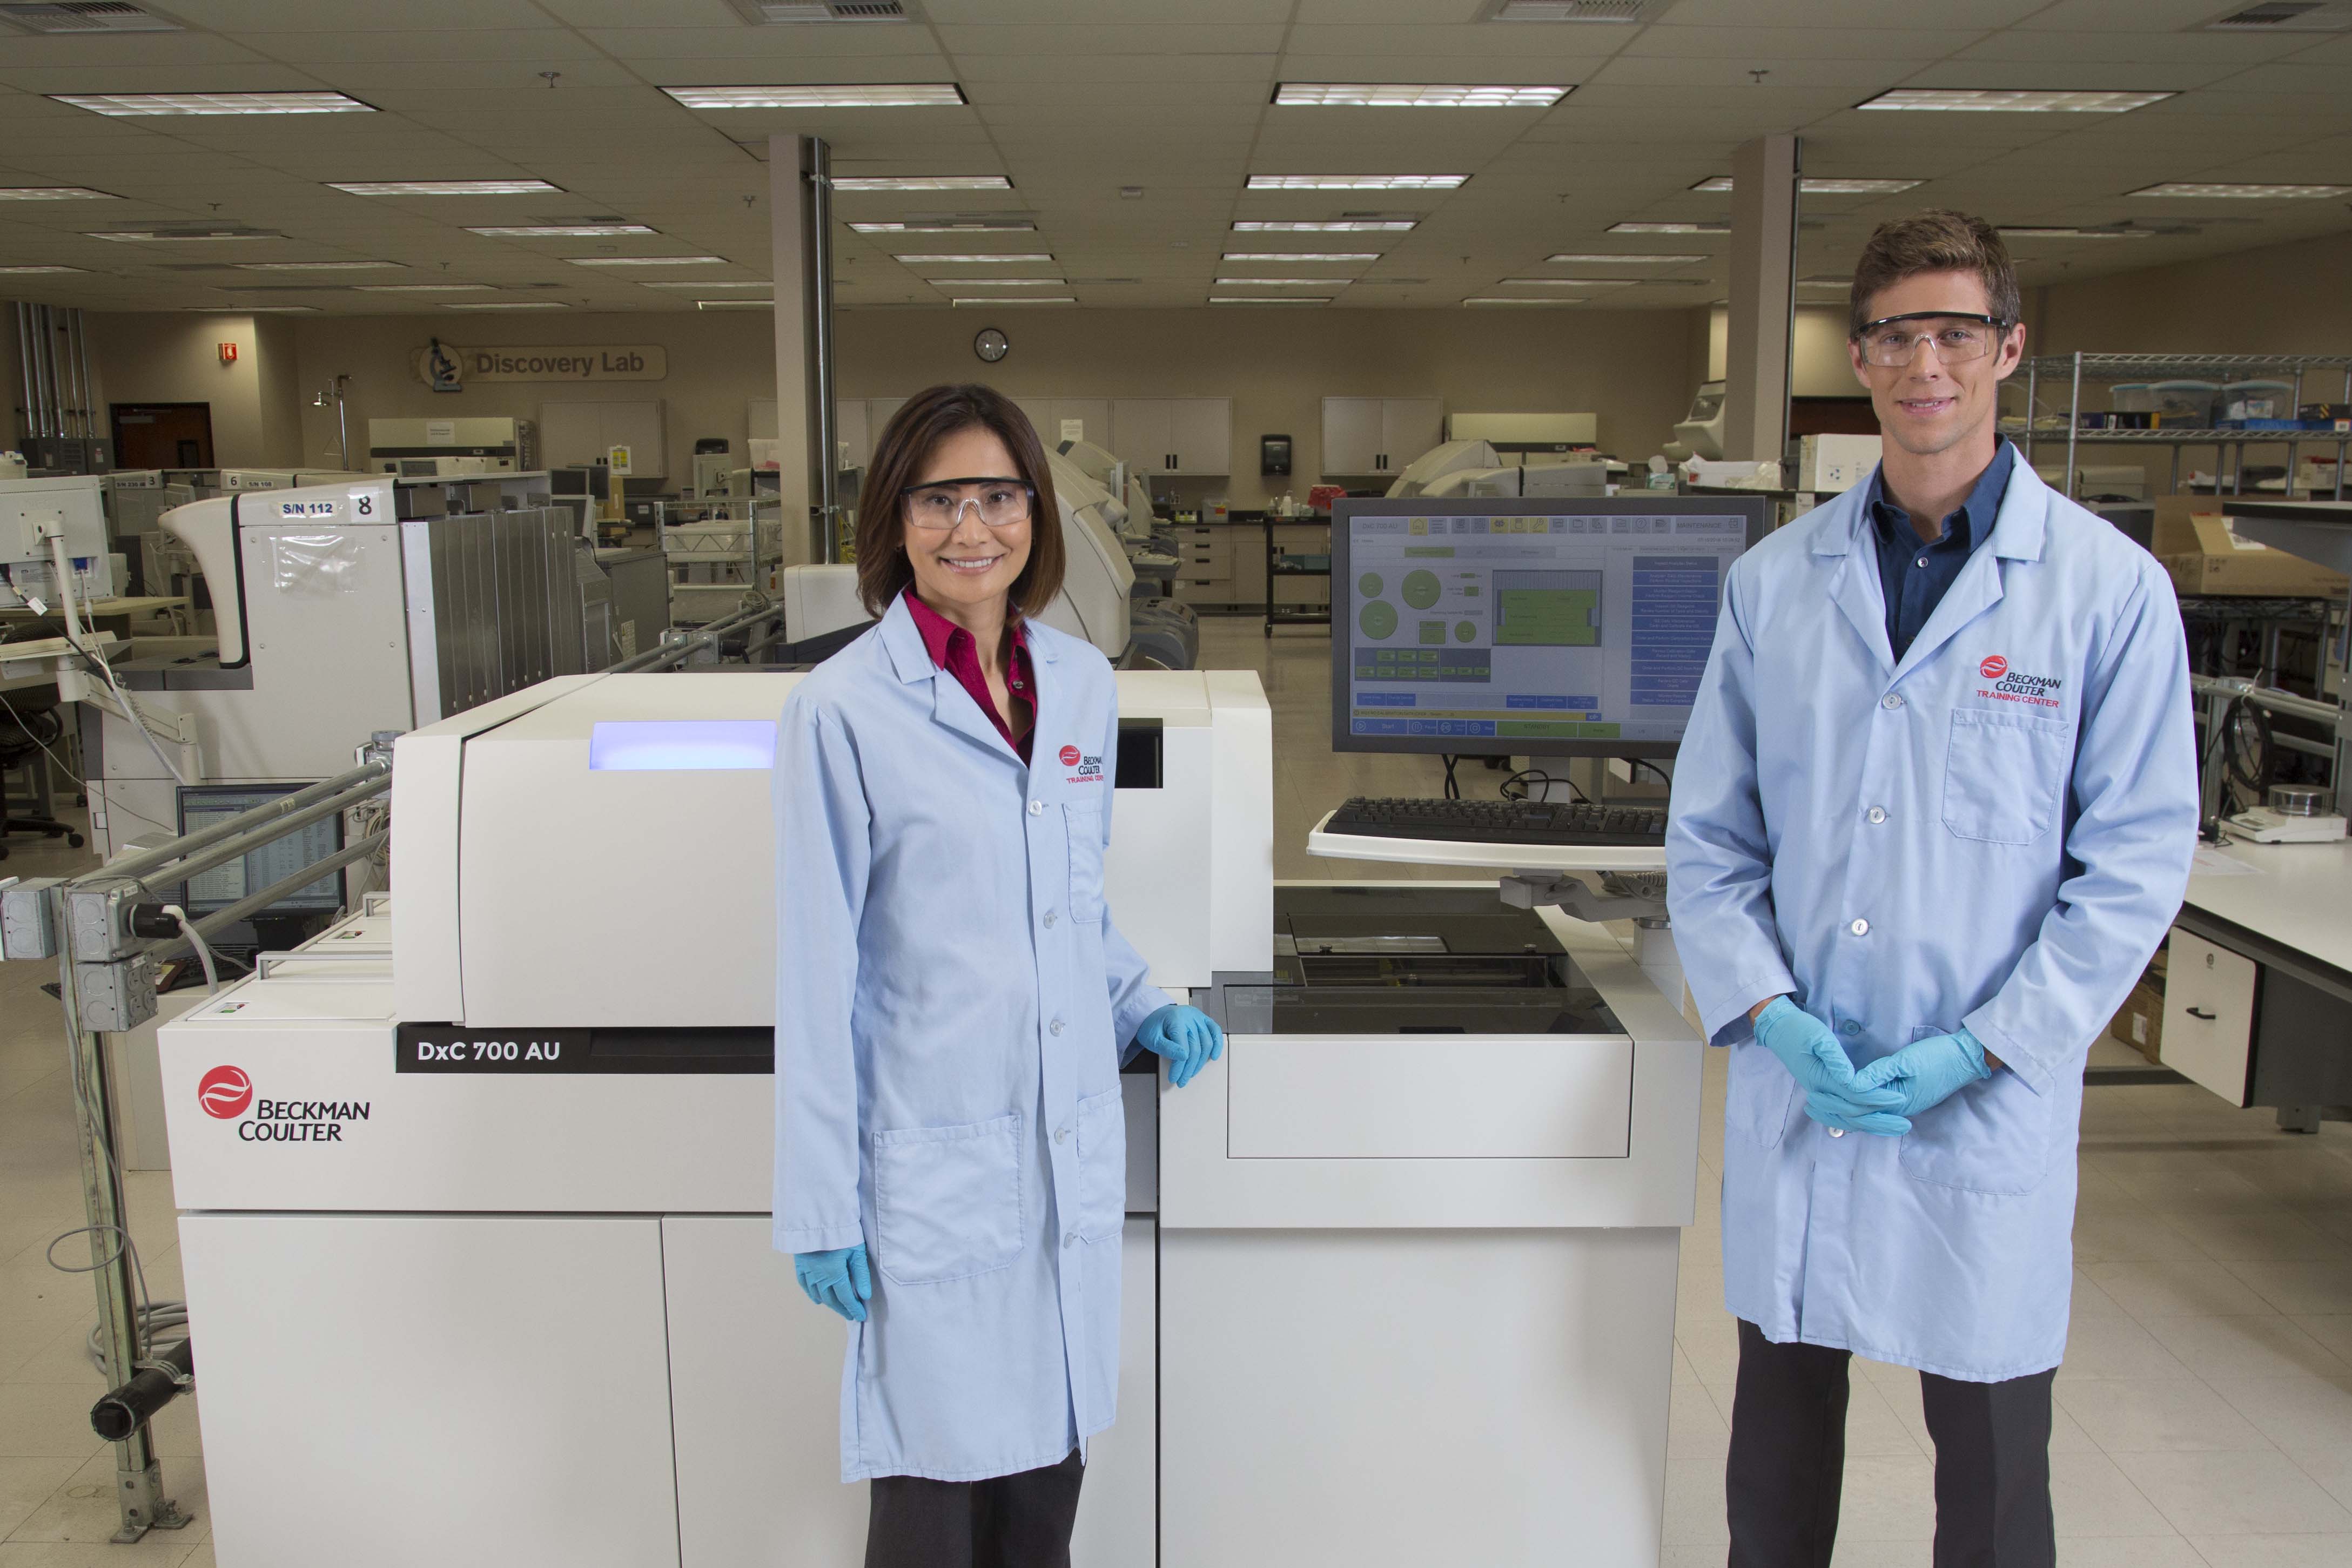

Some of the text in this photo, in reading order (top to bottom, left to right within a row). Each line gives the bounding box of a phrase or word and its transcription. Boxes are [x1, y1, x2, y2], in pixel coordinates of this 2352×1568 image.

[476, 352, 644, 376] Discovery Lab
[148, 476, 155, 485] 3
[231, 476, 237, 486] 6
[283, 503, 333, 514] S/N 112
[358, 496, 372, 515] 8
[1995, 681, 2045, 697] COULTER
[2006, 672, 2061, 689] BECKMAN
[1976, 690, 2059, 708] TRAINING CENTER
[1066, 776, 1094, 784] TRAINING
[418, 1042, 560, 1060] DxC 700 AU
[257, 1099, 371, 1120] BECKMAN
[238, 1121, 342, 1142] COULTER
